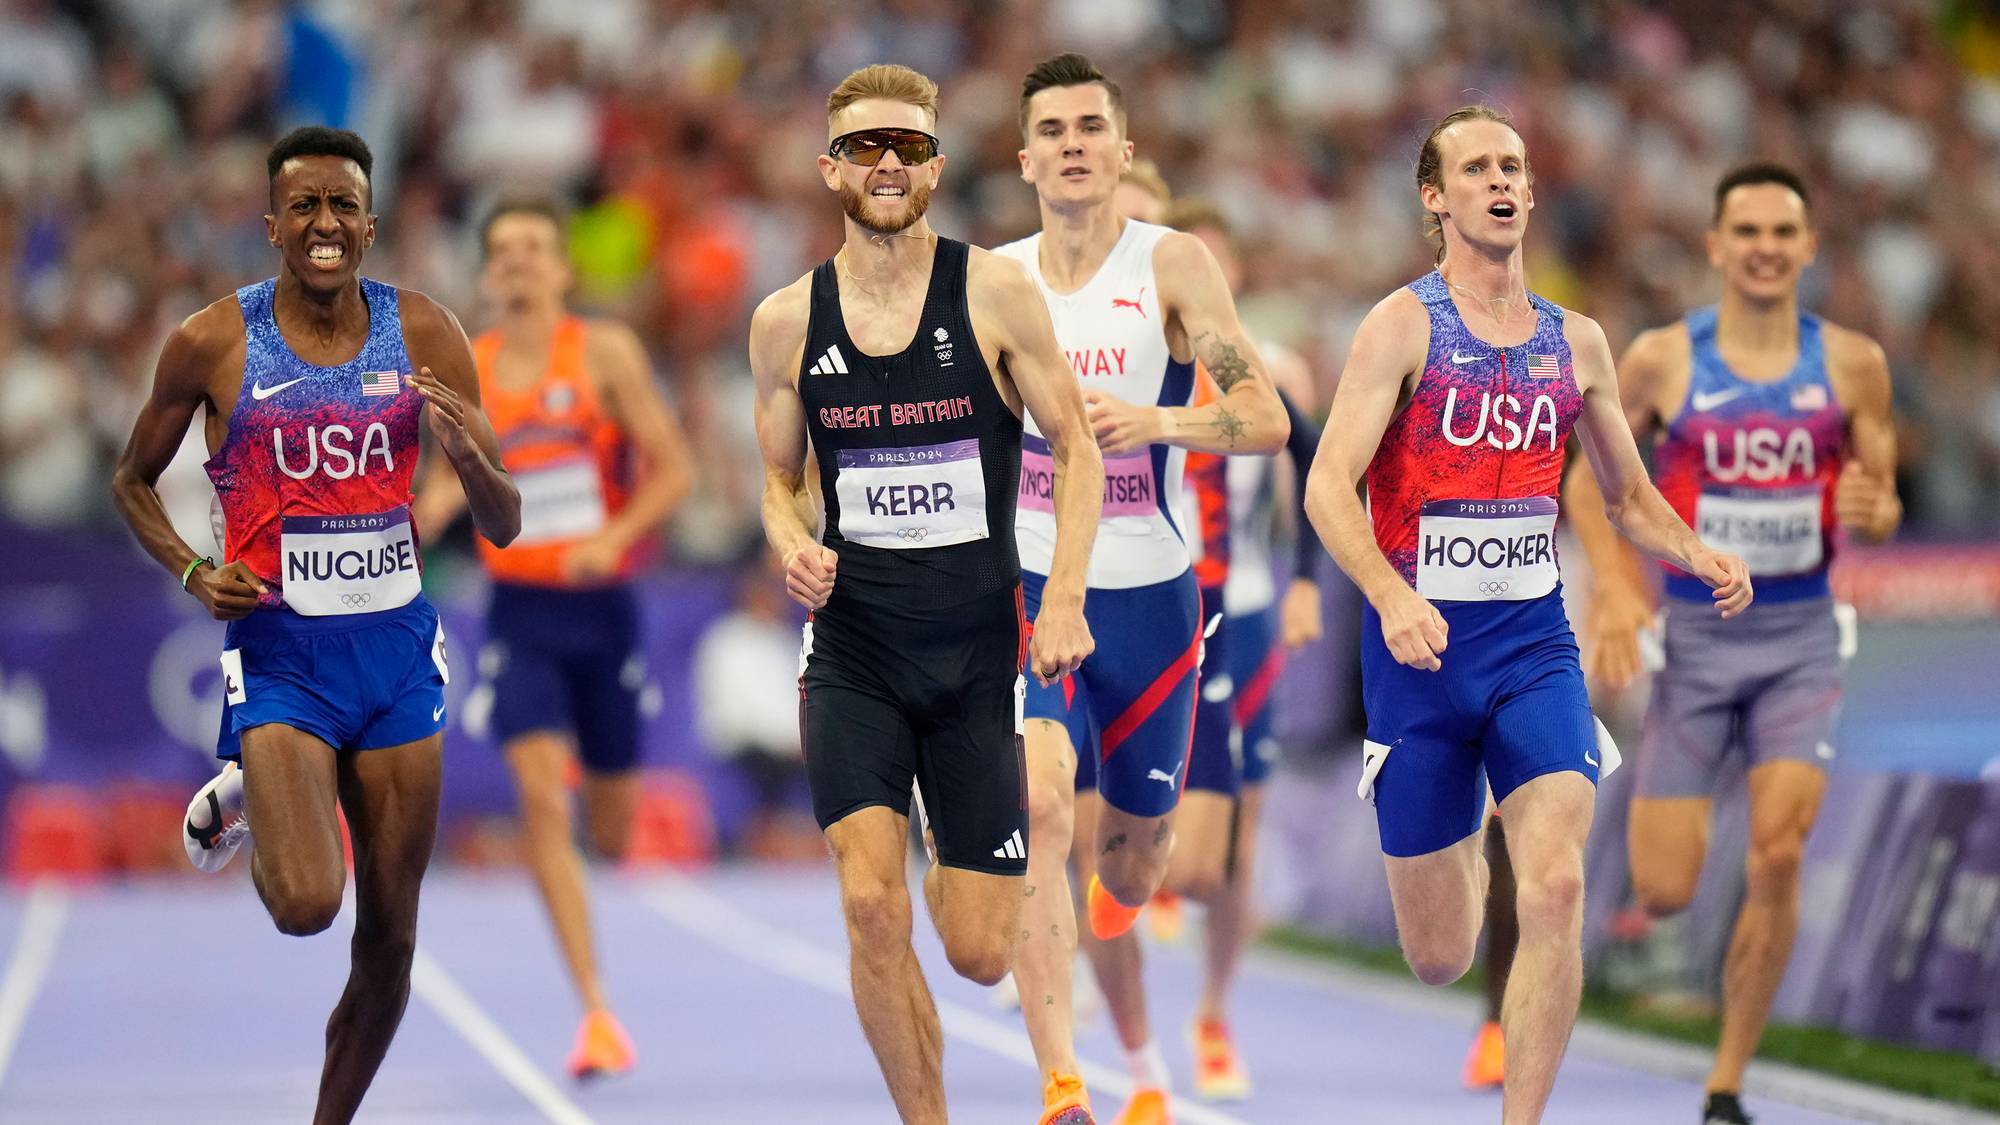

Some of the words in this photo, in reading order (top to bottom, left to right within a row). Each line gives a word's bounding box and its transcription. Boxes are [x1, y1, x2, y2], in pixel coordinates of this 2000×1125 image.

[1066, 348, 1126, 376] WAY
[819, 405, 882, 428] GREAT
[890, 395, 973, 426] BRITAIN
[1442, 388, 1557, 452] USA
[273, 422, 394, 480] USA
[869, 453, 904, 463] PARIS
[909, 450, 943, 461] 2024
[1703, 427, 1816, 482] USA
[865, 482, 956, 516] KERR
[1460, 503, 1497, 514] PARIS
[1501, 503, 1530, 513] 2024
[321, 519, 357, 529] PARIS
[288, 540, 414, 581] NUGUSE
[1424, 532, 1551, 568] HOCKER
